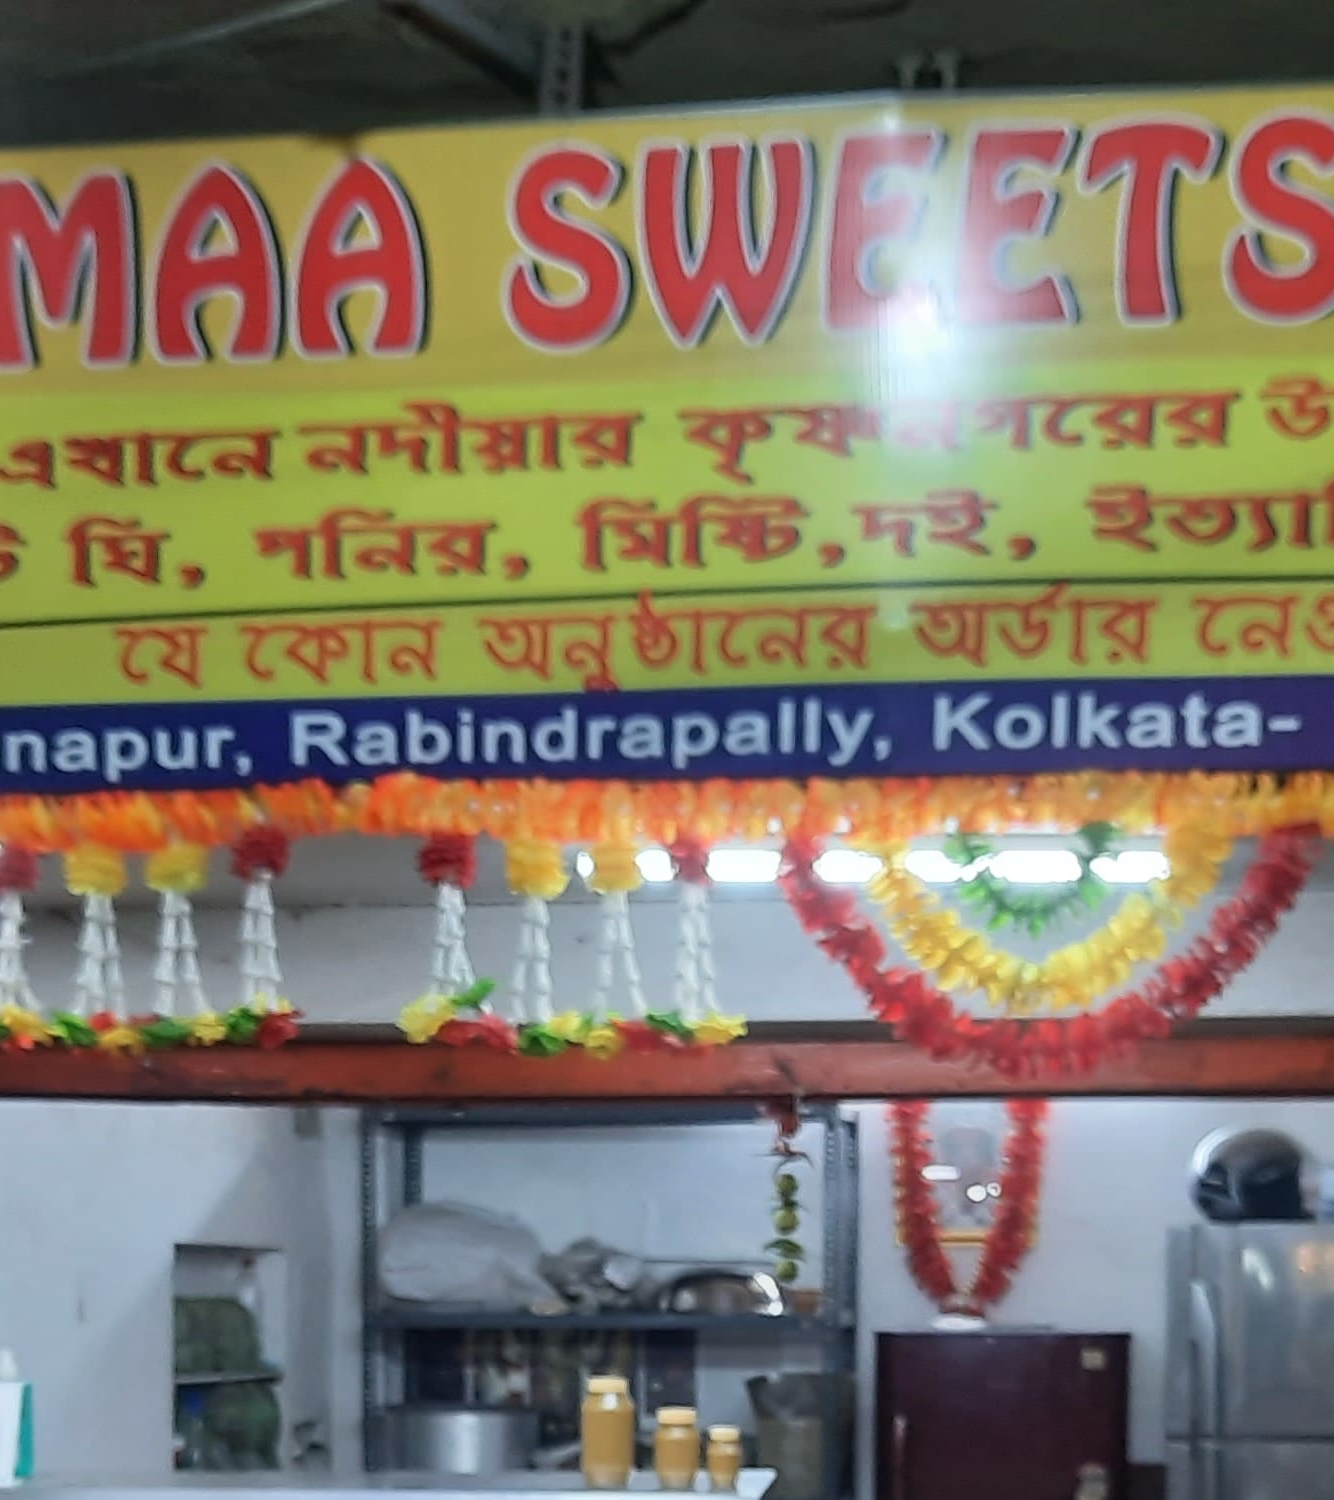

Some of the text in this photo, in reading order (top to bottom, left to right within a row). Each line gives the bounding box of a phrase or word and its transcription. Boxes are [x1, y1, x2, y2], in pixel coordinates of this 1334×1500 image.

[115, 622, 207, 688] যে
[239, 618, 442, 685] কোন
[478, 588, 875, 692] অনুষ্ঠানের
[912, 578, 1159, 668] অর্ডার
[289, 698, 893, 770] Rabindrapally,
[932, 690, 1300, 752] Kolkata-
